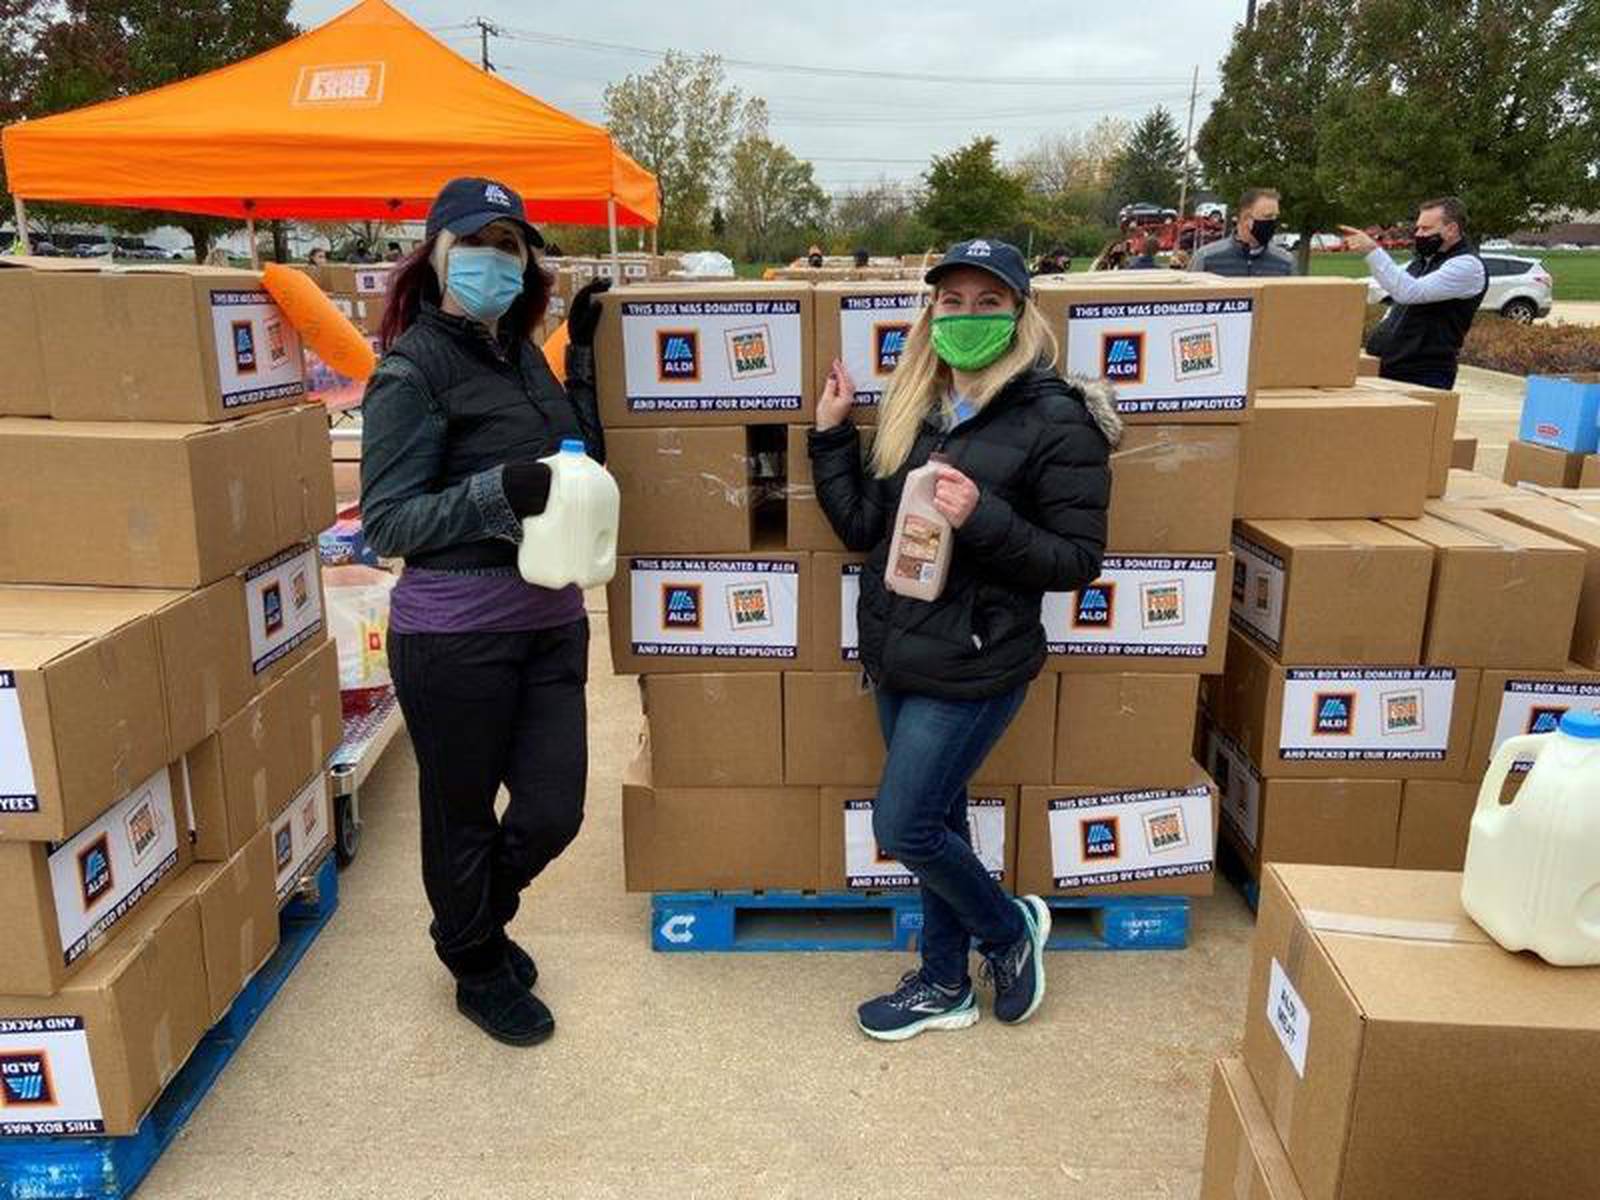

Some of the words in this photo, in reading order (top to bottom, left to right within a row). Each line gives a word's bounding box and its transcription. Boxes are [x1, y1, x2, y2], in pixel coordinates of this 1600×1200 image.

[628, 304, 653, 314] THIS
[655, 304, 677, 314] BOX
[679, 304, 702, 314] WAS
[704, 303, 754, 314] DONATED
[756, 302, 770, 313] BY
[772, 302, 798, 313] ALDI
[848, 298, 872, 308] THIS
[874, 298, 896, 308] BOX
[1075, 307, 1100, 318] THIS
[1102, 306, 1125, 316] BOX
[1127, 305, 1150, 316] WAS
[1153, 304, 1203, 315] DONATED
[1206, 302, 1220, 313] BY
[1222, 301, 1248, 312] ALDI
[664, 361, 694, 372] ALDI
[1107, 364, 1137, 374] ALDI
[1181, 357, 1214, 374] BANK
[634, 399, 655, 410] AND
[715, 398, 738, 408] OUR
[740, 397, 799, 408] EMPLOYEES
[1156, 400, 1180, 410] OUR
[1182, 397, 1243, 410] EMPLOYEES
[661, 561, 682, 570] BOX
[684, 561, 706, 570] WAS
[708, 562, 755, 572] DONATED
[1124, 560, 1171, 570] DONATED
[1173, 560, 1187, 570] BY
[1188, 560, 1214, 570] ALDI
[668, 612, 696, 622] ALDI
[1079, 611, 1107, 622] ALDI
[638, 646, 659, 656] AND
[716, 646, 738, 656] OUR
[738, 646, 794, 658] EMPLOYEES
[1068, 645, 1106, 655] PACKED
[1108, 646, 1122, 655] BY
[1124, 646, 1145, 655] OUR
[1147, 646, 1204, 656] EMPLOYEES
[1341, 670, 1362, 680] WAS
[1428, 670, 1452, 680] ALDI
[1319, 718, 1347, 728] ALDI
[1284, 750, 1306, 760] AND
[1088, 843, 1115, 854] ALDI
[852, 877, 872, 888] AND
[874, 876, 910, 887] PACKED
[1059, 878, 1080, 888] AND
[0, 1019, 43, 1031] PACKE
[46, 1018, 76, 1029] AND
[2, 1062, 40, 1074] ALDI
[3, 1122, 33, 1135] WAS
[36, 1122, 63, 1134] BOX
[65, 1120, 97, 1132] THIS
